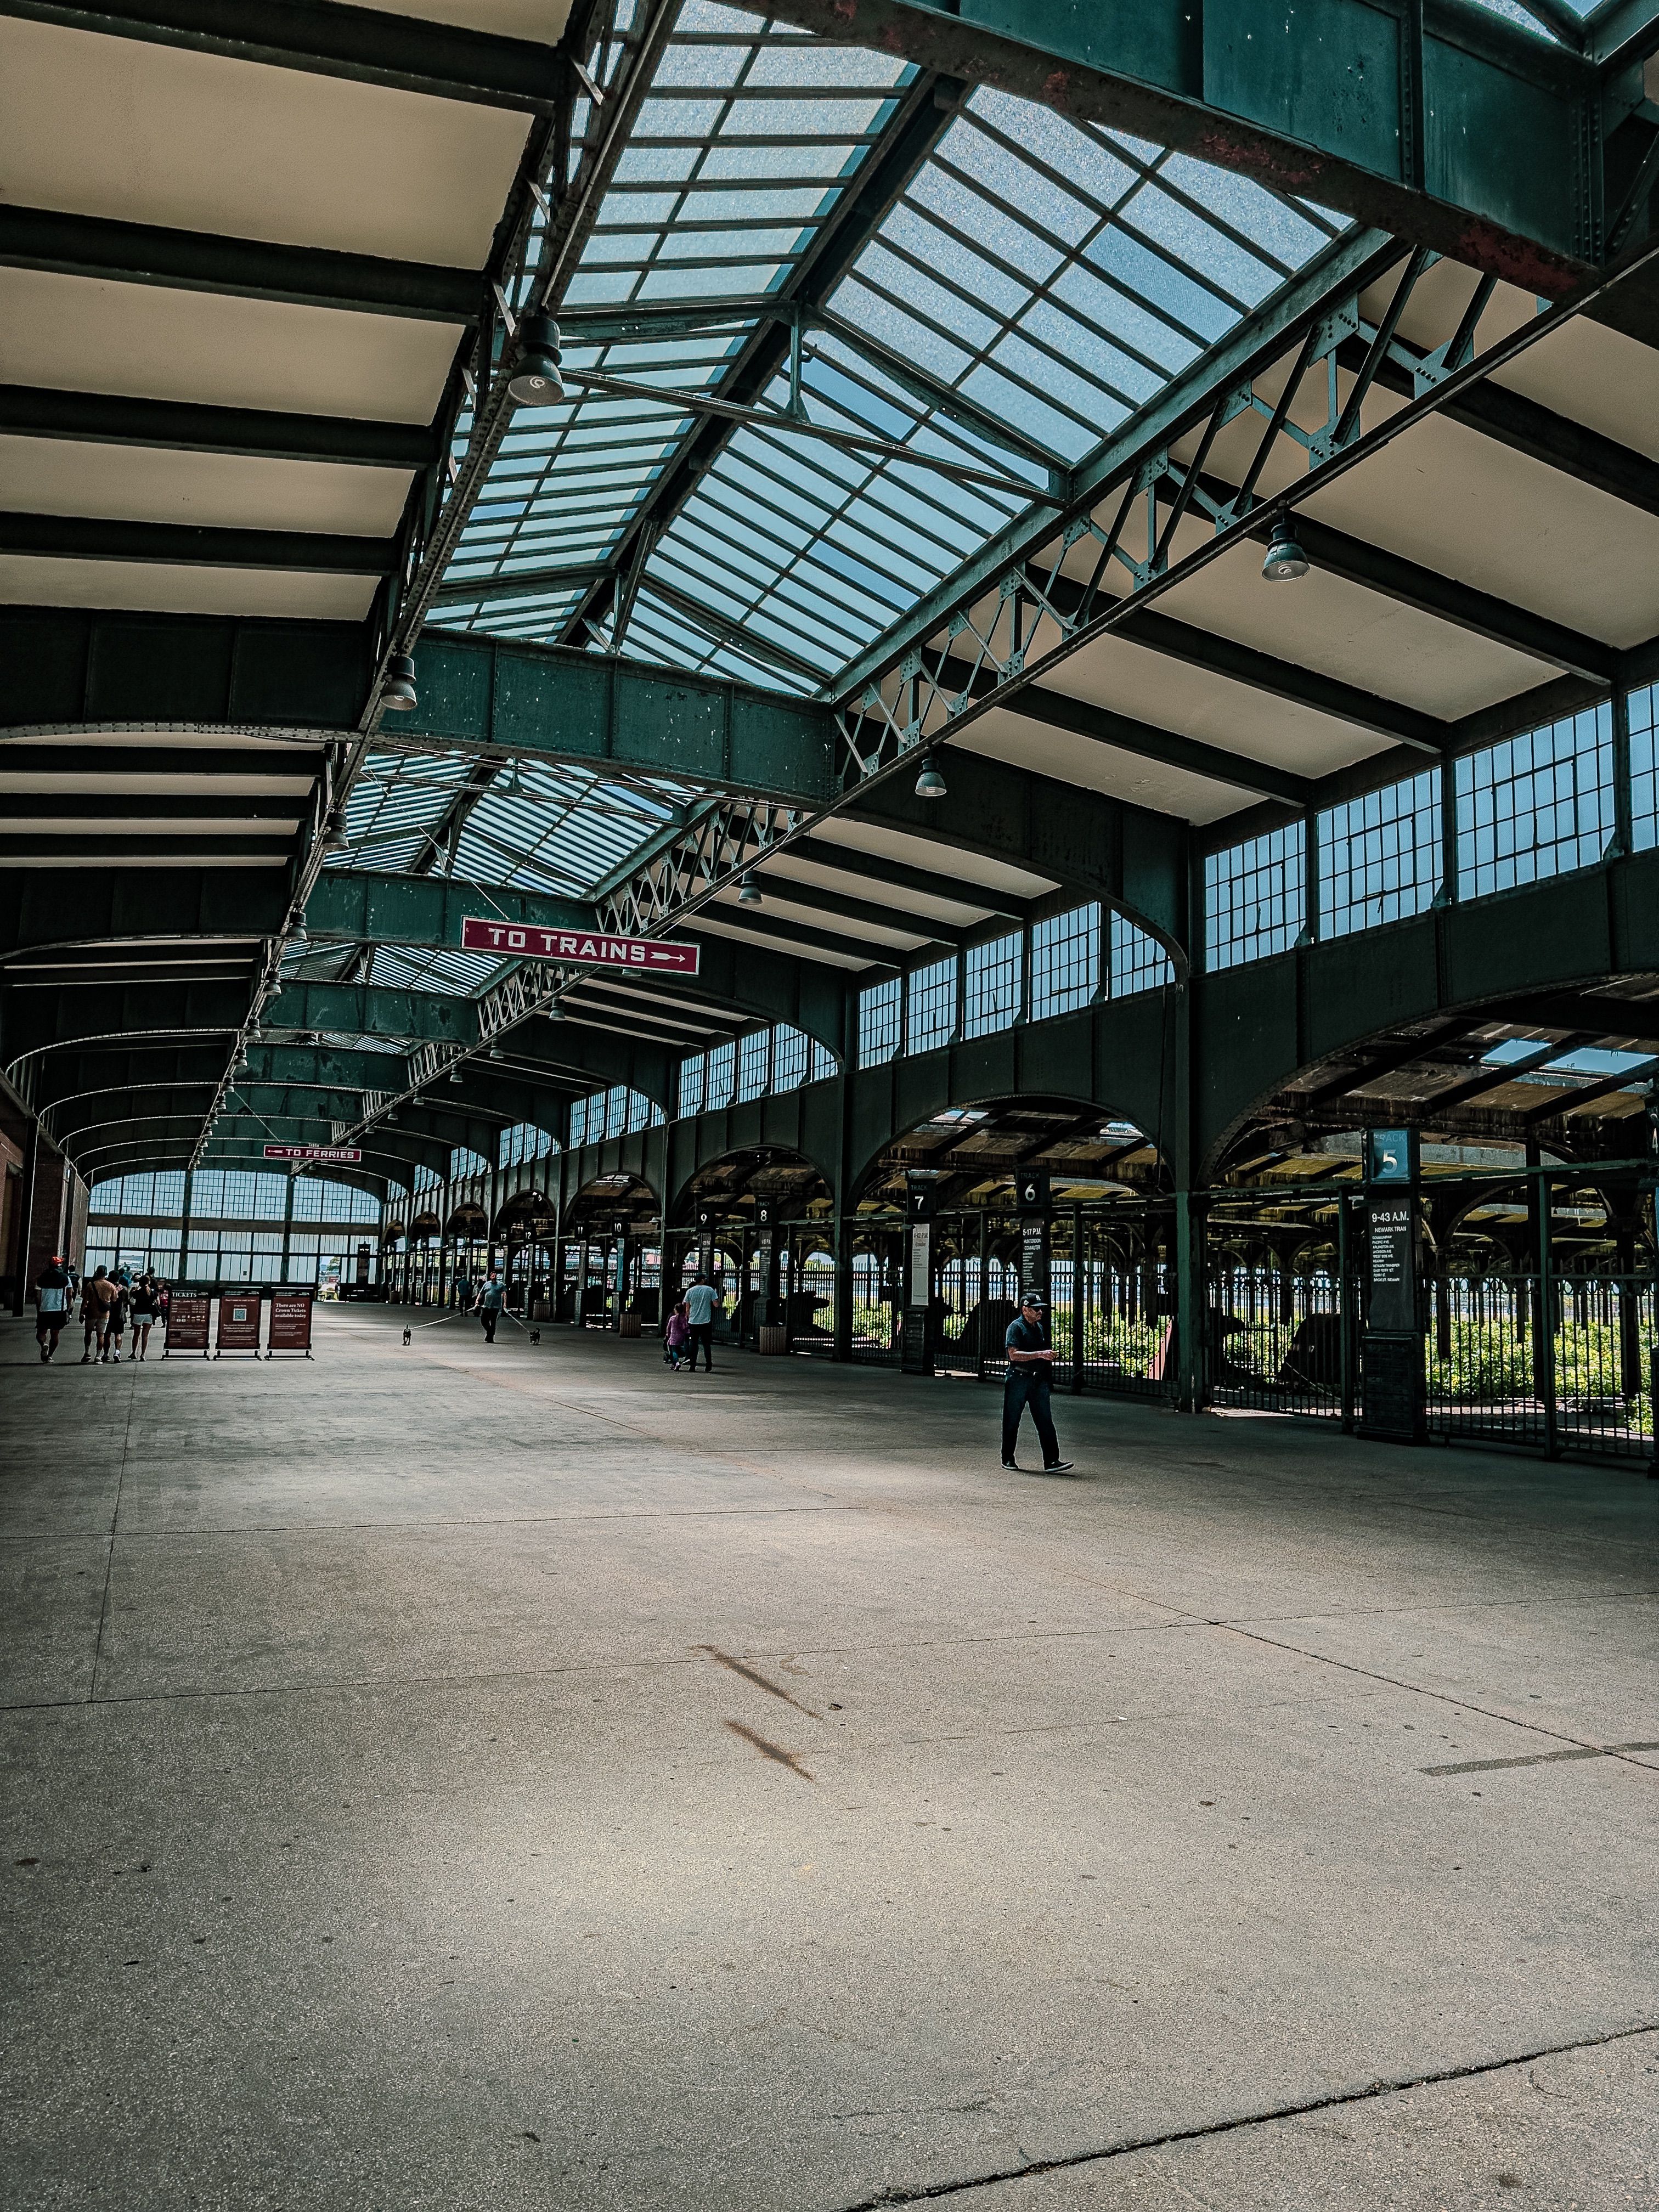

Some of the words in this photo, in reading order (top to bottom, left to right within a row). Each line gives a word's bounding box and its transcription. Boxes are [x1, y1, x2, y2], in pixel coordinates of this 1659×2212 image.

[488, 928, 526, 948] TO
[540, 934, 645, 962] TRAINS
[1374, 1133, 1406, 1142] TRACK
[306, 1149, 354, 1159] FERRIES
[1383, 1149, 1397, 1173] 5
[1025, 1183, 1035, 1201] 6
[915, 1195, 924, 1210] 7
[701, 1214, 707, 1224] 9
[760, 1210, 767, 1222] 8
[1372, 1212, 1391, 1223] 9-43
[1392, 1211, 1409, 1222] A.M.
[578, 1226, 583, 1234] 11
[614, 1223, 622, 1232] 10
